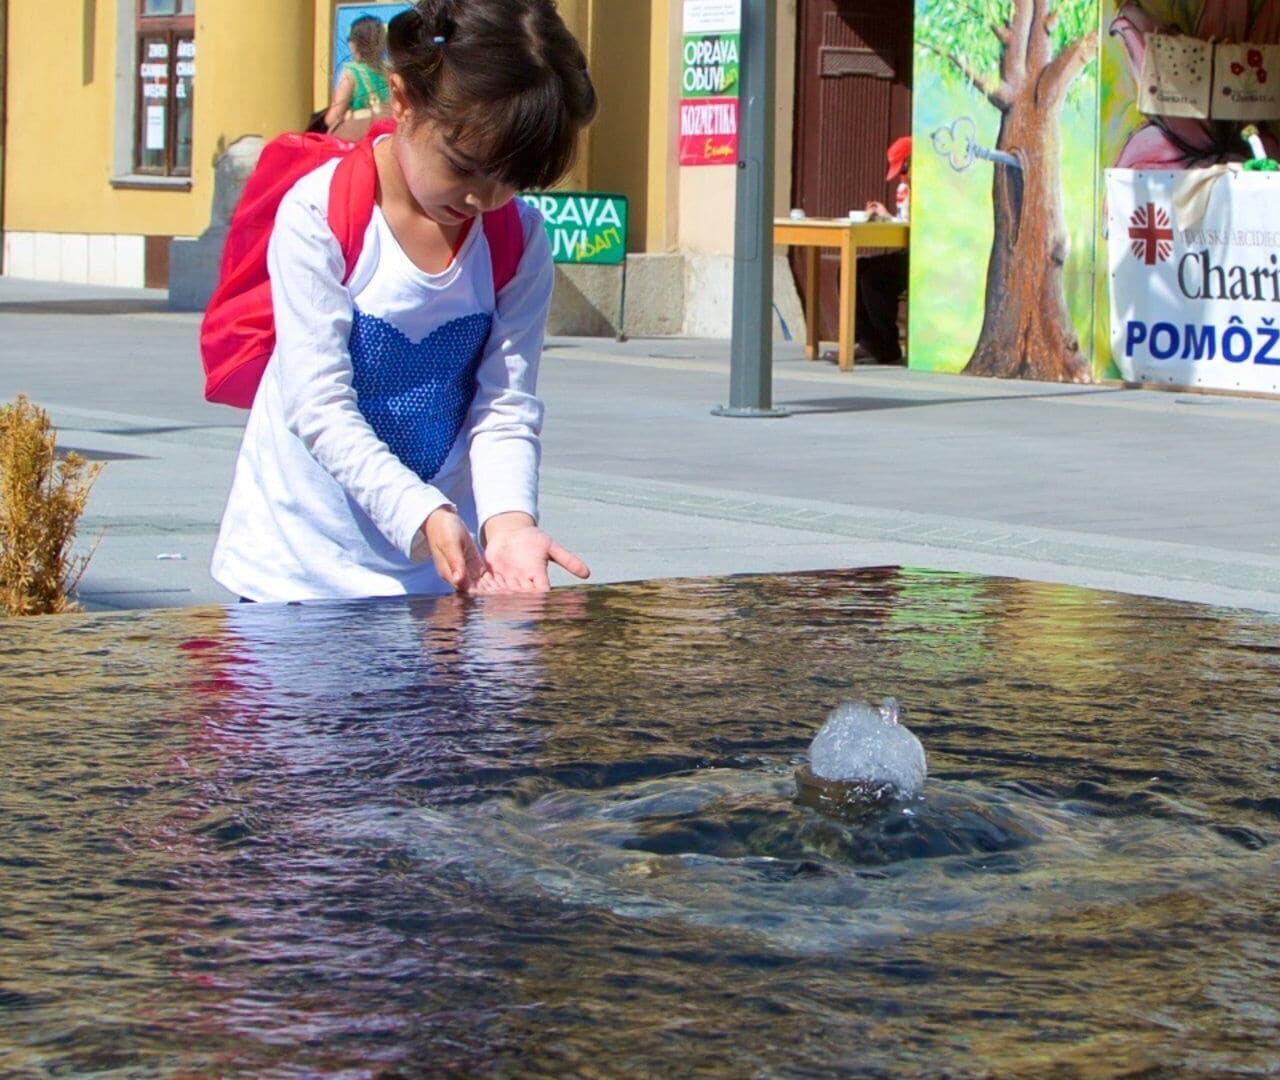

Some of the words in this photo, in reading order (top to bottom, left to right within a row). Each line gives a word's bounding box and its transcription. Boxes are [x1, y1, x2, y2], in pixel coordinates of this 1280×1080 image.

[684, 40, 738, 65] OPRAVA
[681, 105, 736, 135] KOZMETIKA
[522, 195, 622, 227] PRAVA
